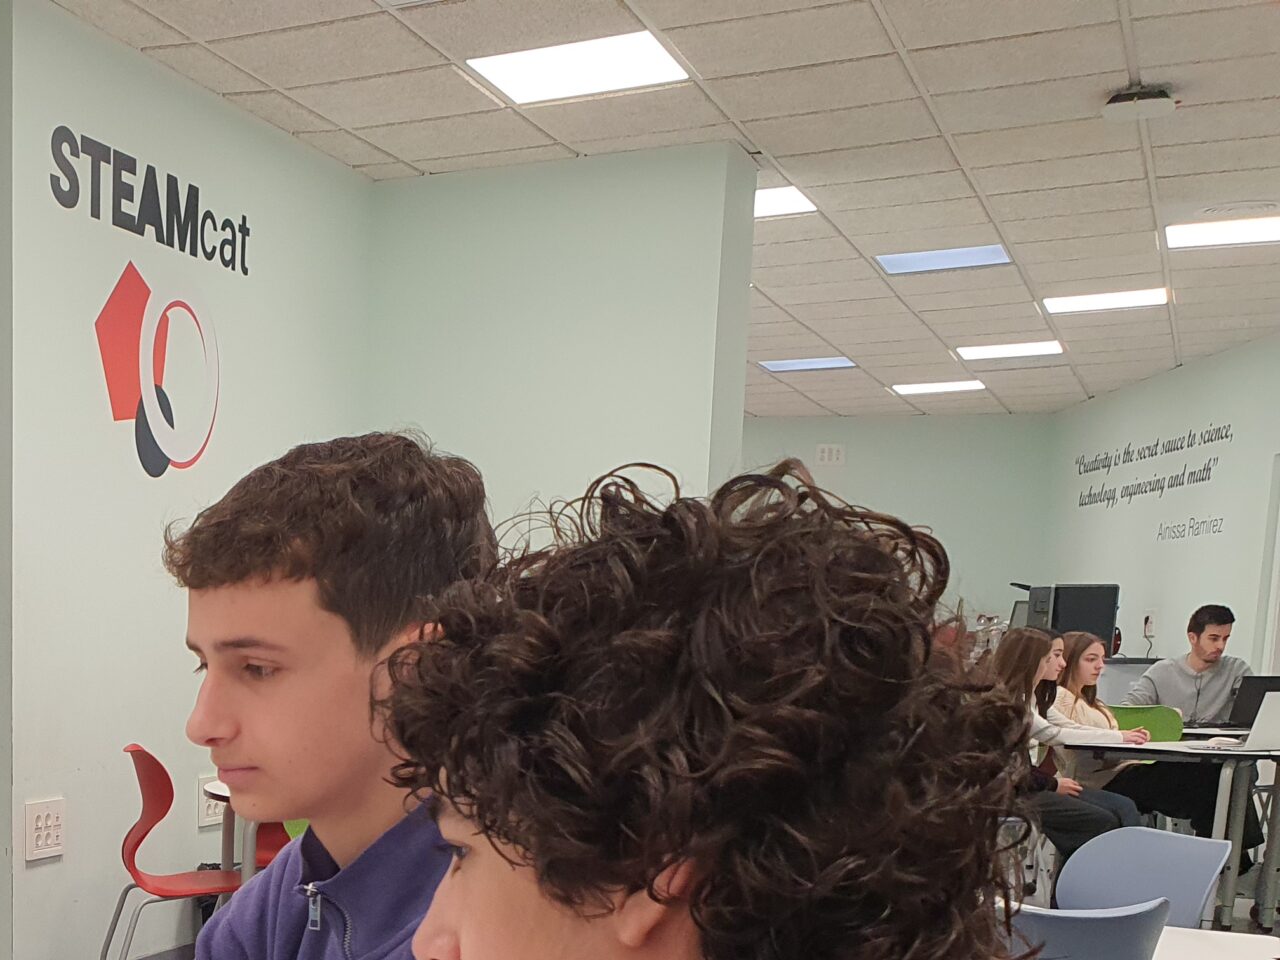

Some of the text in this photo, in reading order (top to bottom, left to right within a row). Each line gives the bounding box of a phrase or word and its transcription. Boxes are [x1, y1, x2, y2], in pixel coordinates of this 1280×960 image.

[49, 124, 251, 276] STEAMcat
[1114, 449, 1121, 467] is
[1122, 442, 1134, 465] the
[1135, 438, 1160, 462] secret
[1160, 436, 1185, 455] sauce
[1186, 429, 1196, 448] to
[1198, 422, 1233, 446] science,
[1078, 482, 1118, 509] technology,
[1120, 473, 1166, 504] engineering
[1167, 463, 1187, 490] and
[1156, 513, 1224, 541] Ainissa Ramirez
